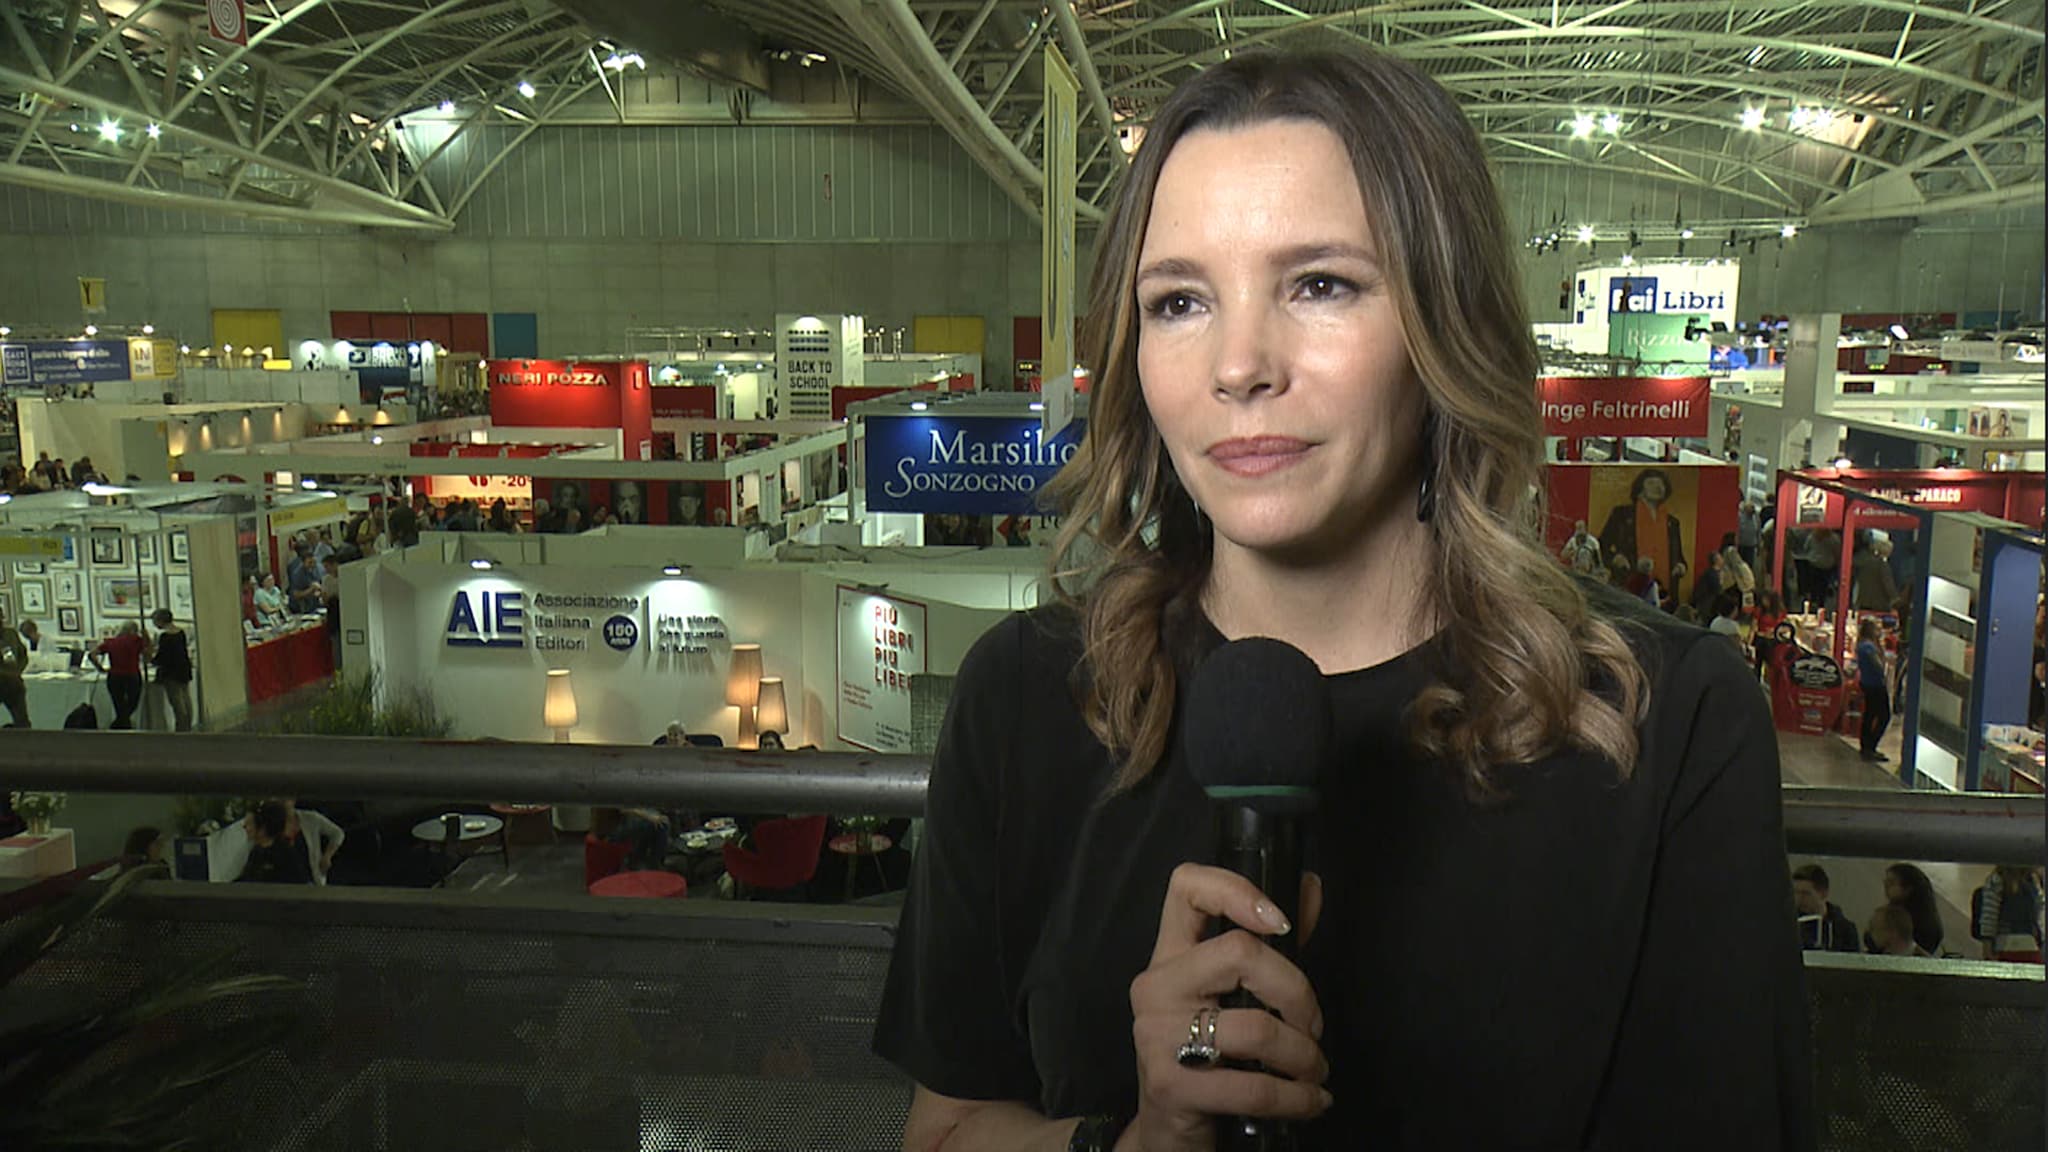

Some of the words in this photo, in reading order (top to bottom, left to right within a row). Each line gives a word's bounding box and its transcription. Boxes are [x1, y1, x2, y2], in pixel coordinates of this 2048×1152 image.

[1663, 291, 1724, 310] Libri
[1627, 329, 1684, 352] Rizzo
[788, 360, 816, 373] BACK
[820, 361, 833, 373] TO
[499, 372, 542, 385] NERI
[547, 372, 608, 386] POZZA
[789, 375, 829, 388] SCHOOL
[1541, 400, 1586, 423] Inge
[1592, 400, 1690, 419] Feltrinelli
[928, 429, 1080, 465] Marsilio
[533, 593, 639, 609] Associazione
[448, 591, 523, 633] AIE
[534, 614, 591, 629] Italiana
[606, 623, 635, 637] 150
[535, 636, 585, 651] Editori
[875, 625, 913, 651] LIBRI
[875, 666, 912, 690] LIBER
